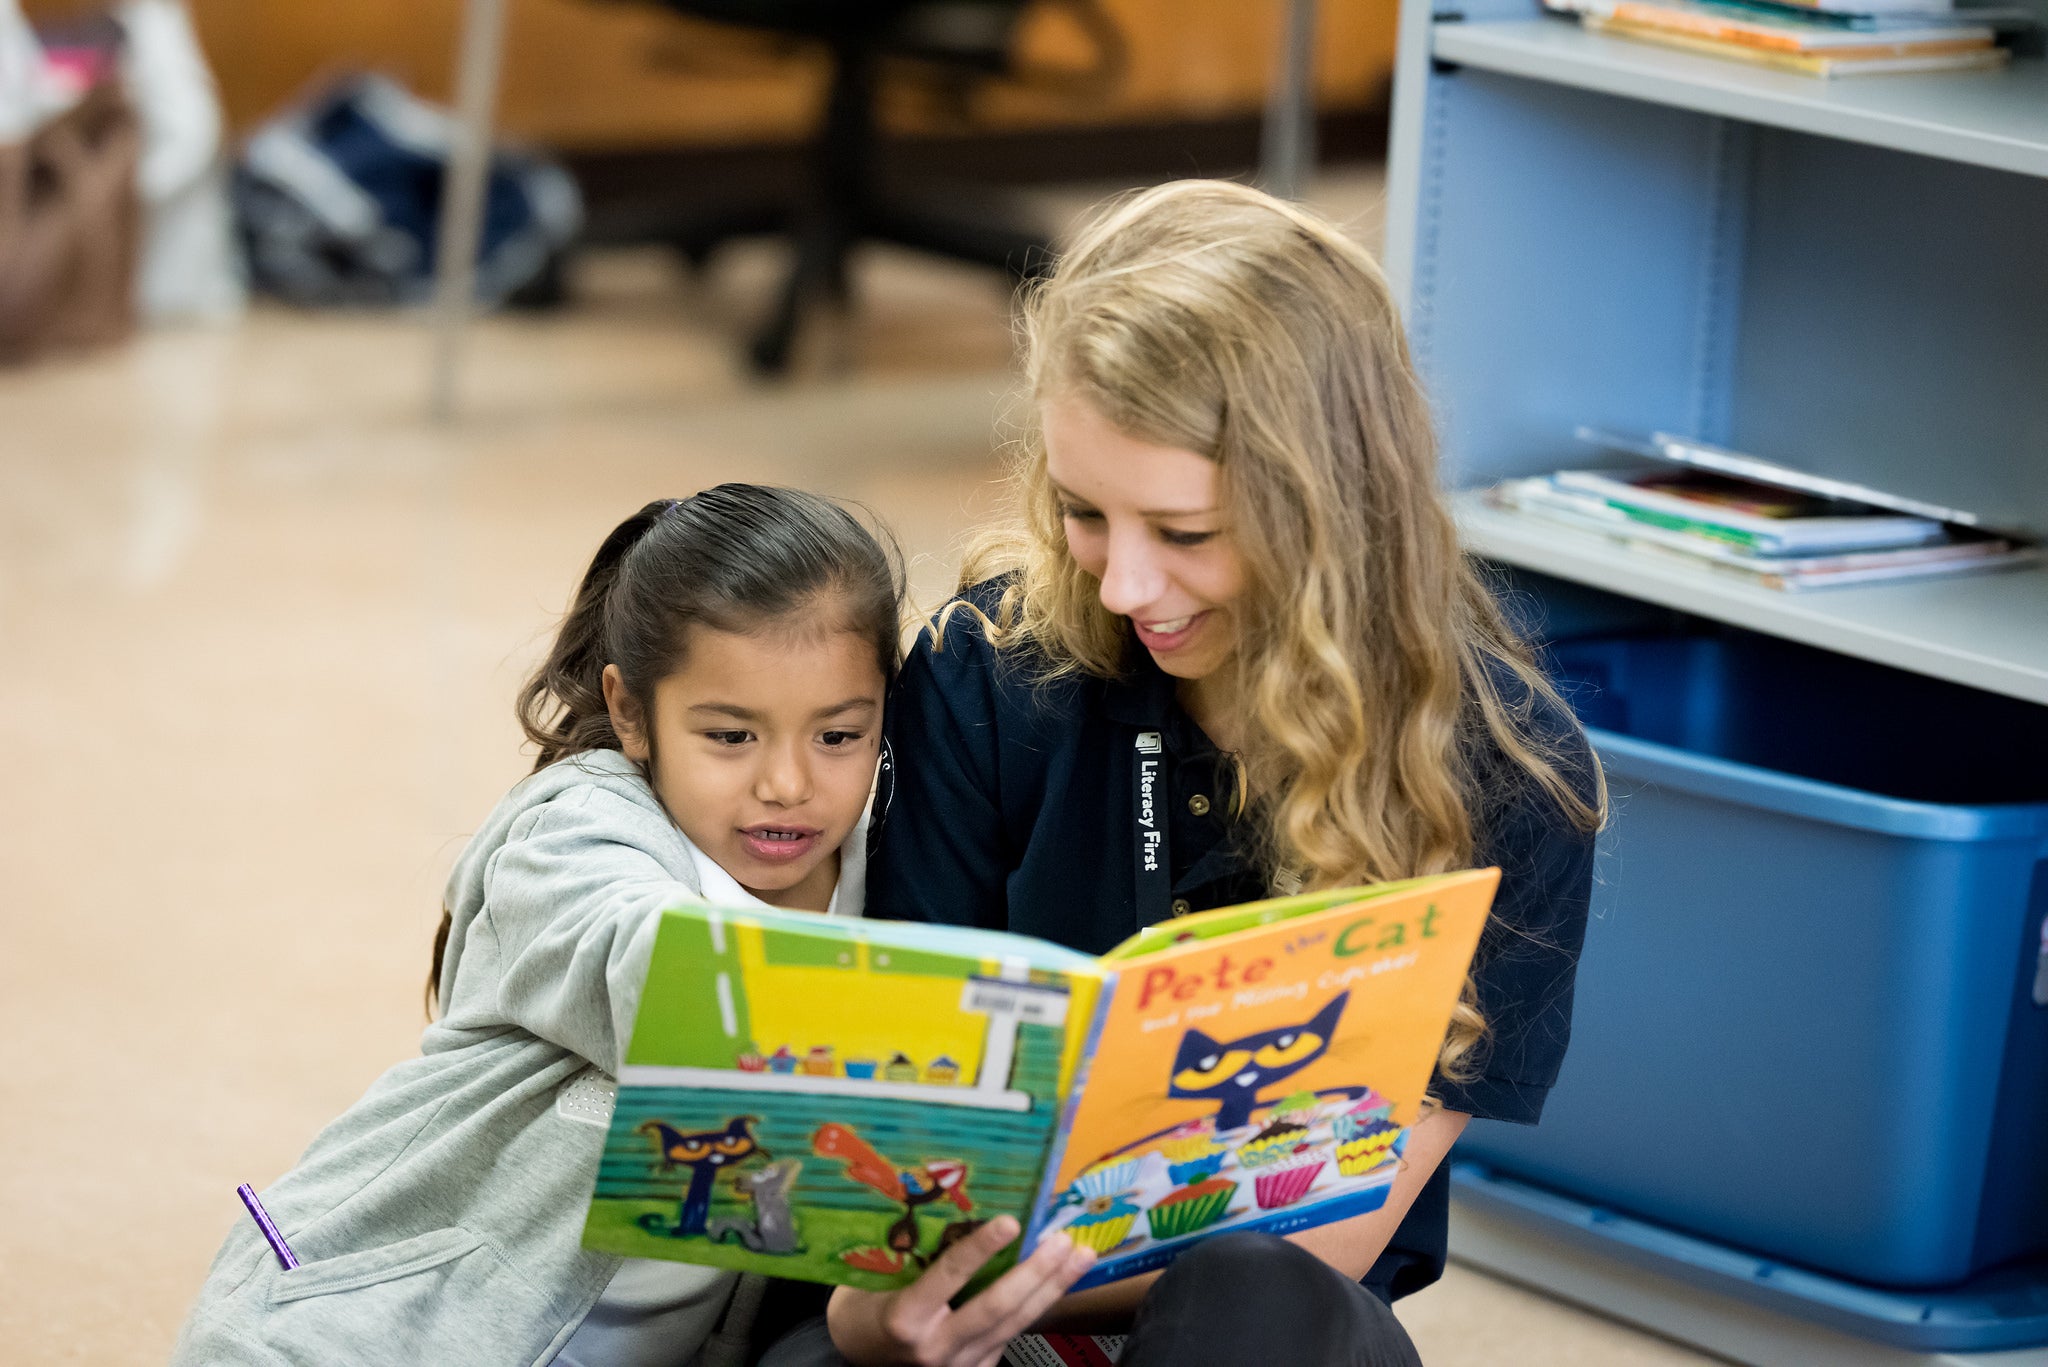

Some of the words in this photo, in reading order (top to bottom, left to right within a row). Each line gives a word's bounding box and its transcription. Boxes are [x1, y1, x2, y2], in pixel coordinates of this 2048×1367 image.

[1138, 761, 1158, 827] Literacy
[1143, 831, 1160, 871] First
[1137, 956, 1274, 1010] Pete
[1333, 903, 1443, 957] Cat
